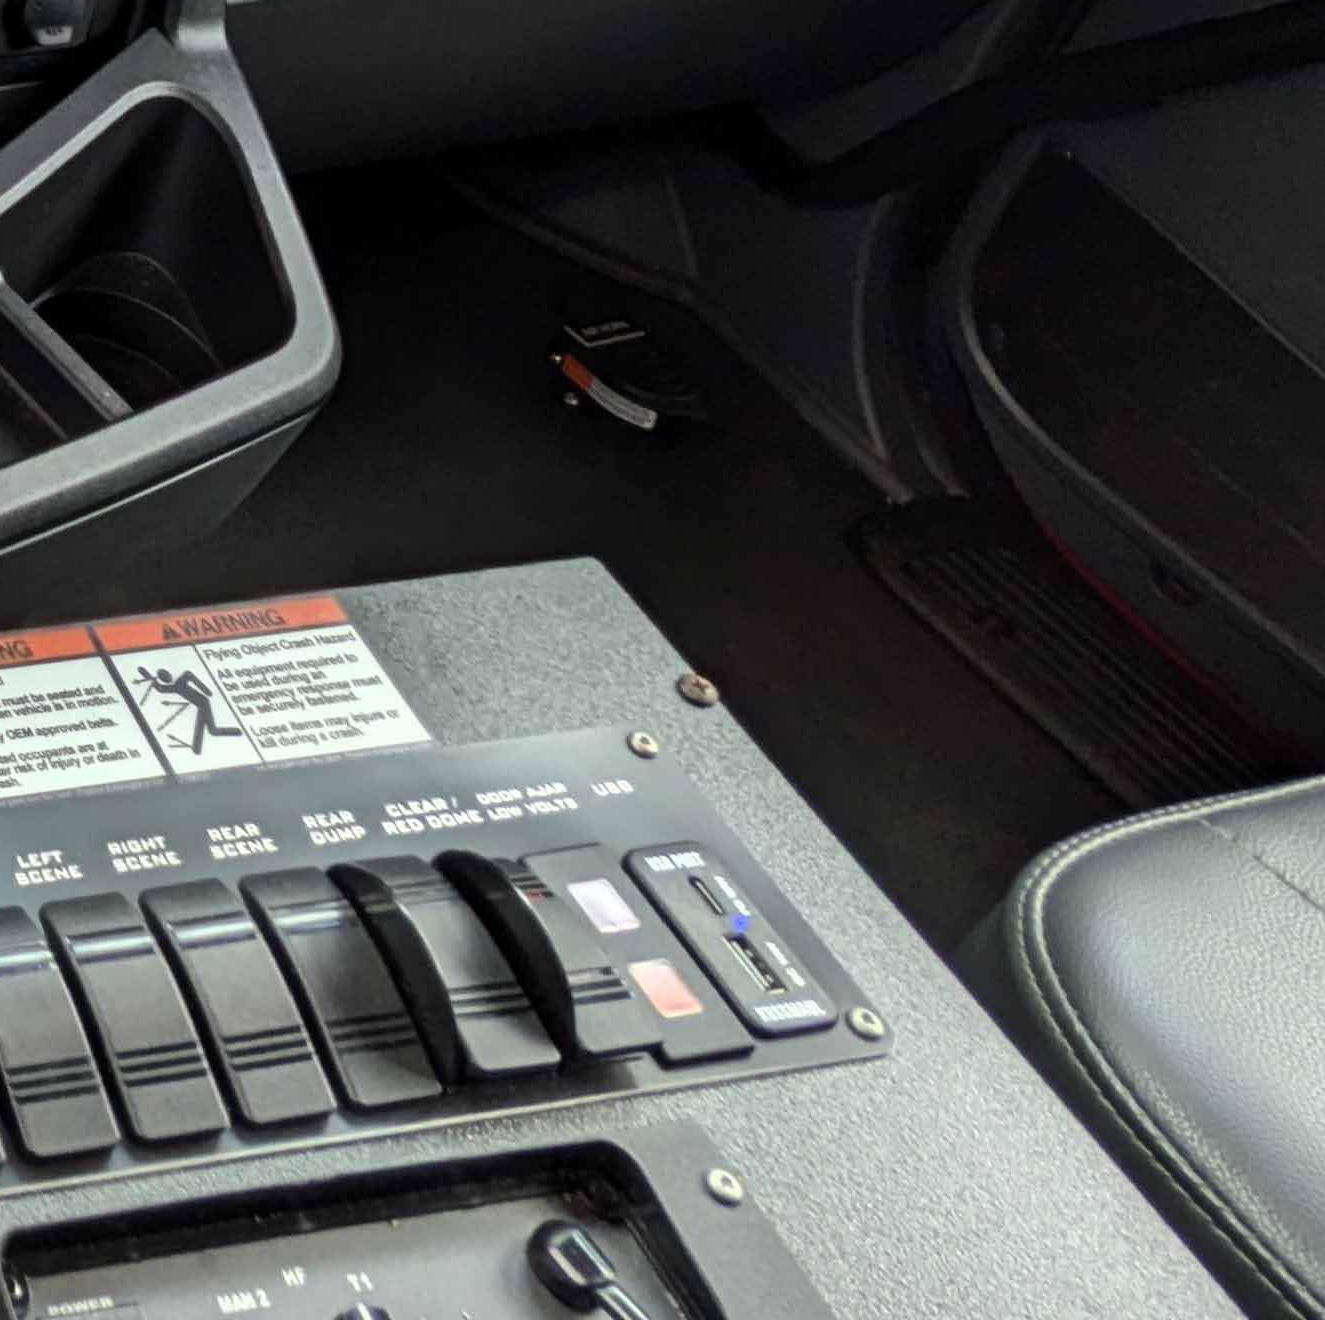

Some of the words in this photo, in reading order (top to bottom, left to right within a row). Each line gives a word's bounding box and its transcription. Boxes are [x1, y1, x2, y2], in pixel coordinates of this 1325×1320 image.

[175, 608, 285, 638] WARNING
[203, 644, 243, 661] Flying
[244, 640, 279, 657] Object
[3, 694, 30, 707] must
[32, 692, 45, 703] be
[86, 684, 105, 697] and
[6, 726, 35, 740] OEM
[36, 720, 87, 739] approved
[18, 746, 77, 764] occupants
[78, 743, 96, 754] are
[98, 741, 109, 751] at
[384, 798, 449, 816] CLEAR
[302, 809, 356, 830] REAR
[381, 816, 425, 836] RED
[427, 808, 484, 828] DOME
[207, 822, 262, 843] REAR
[309, 824, 368, 846] DUMP
[106, 836, 168, 856] RIGHT
[210, 838, 278, 859] SCENE
[16, 849, 64, 869] LEFT
[112, 851, 182, 873] SCENE
[15, 864, 84, 886] SCENE
[47, 1296, 114, 1316] POWER
[217, 1290, 257, 1314] MAN
[257, 1288, 271, 1308] 2
